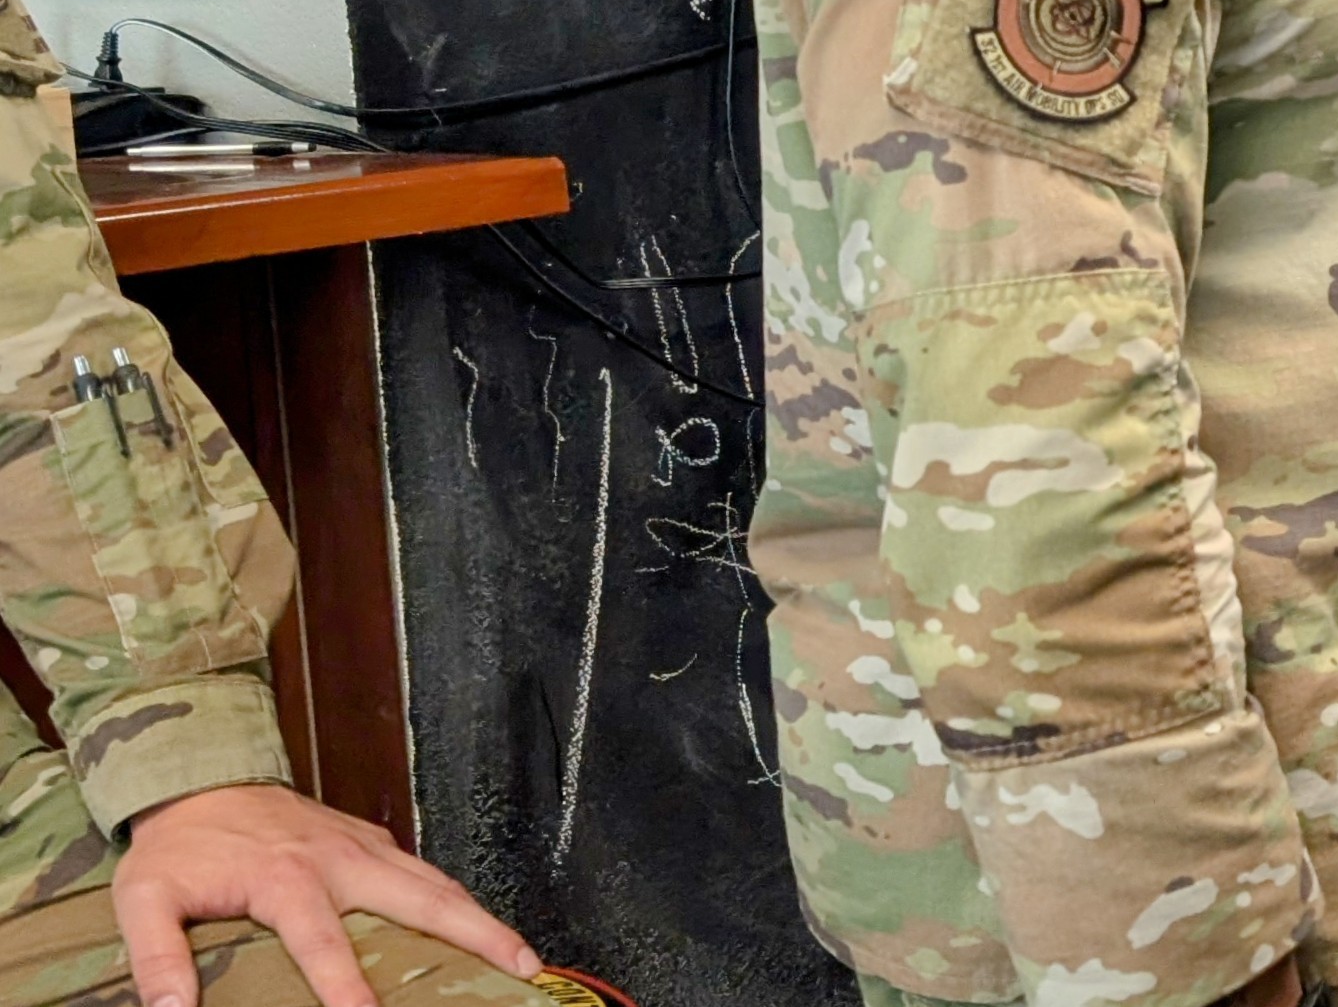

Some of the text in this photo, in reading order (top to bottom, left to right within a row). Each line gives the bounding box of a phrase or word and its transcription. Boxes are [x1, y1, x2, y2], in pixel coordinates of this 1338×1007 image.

[1003, 72, 1026, 93] AIR
[1025, 87, 1081, 115] MOBILITY
[1084, 98, 1107, 115] OPS
